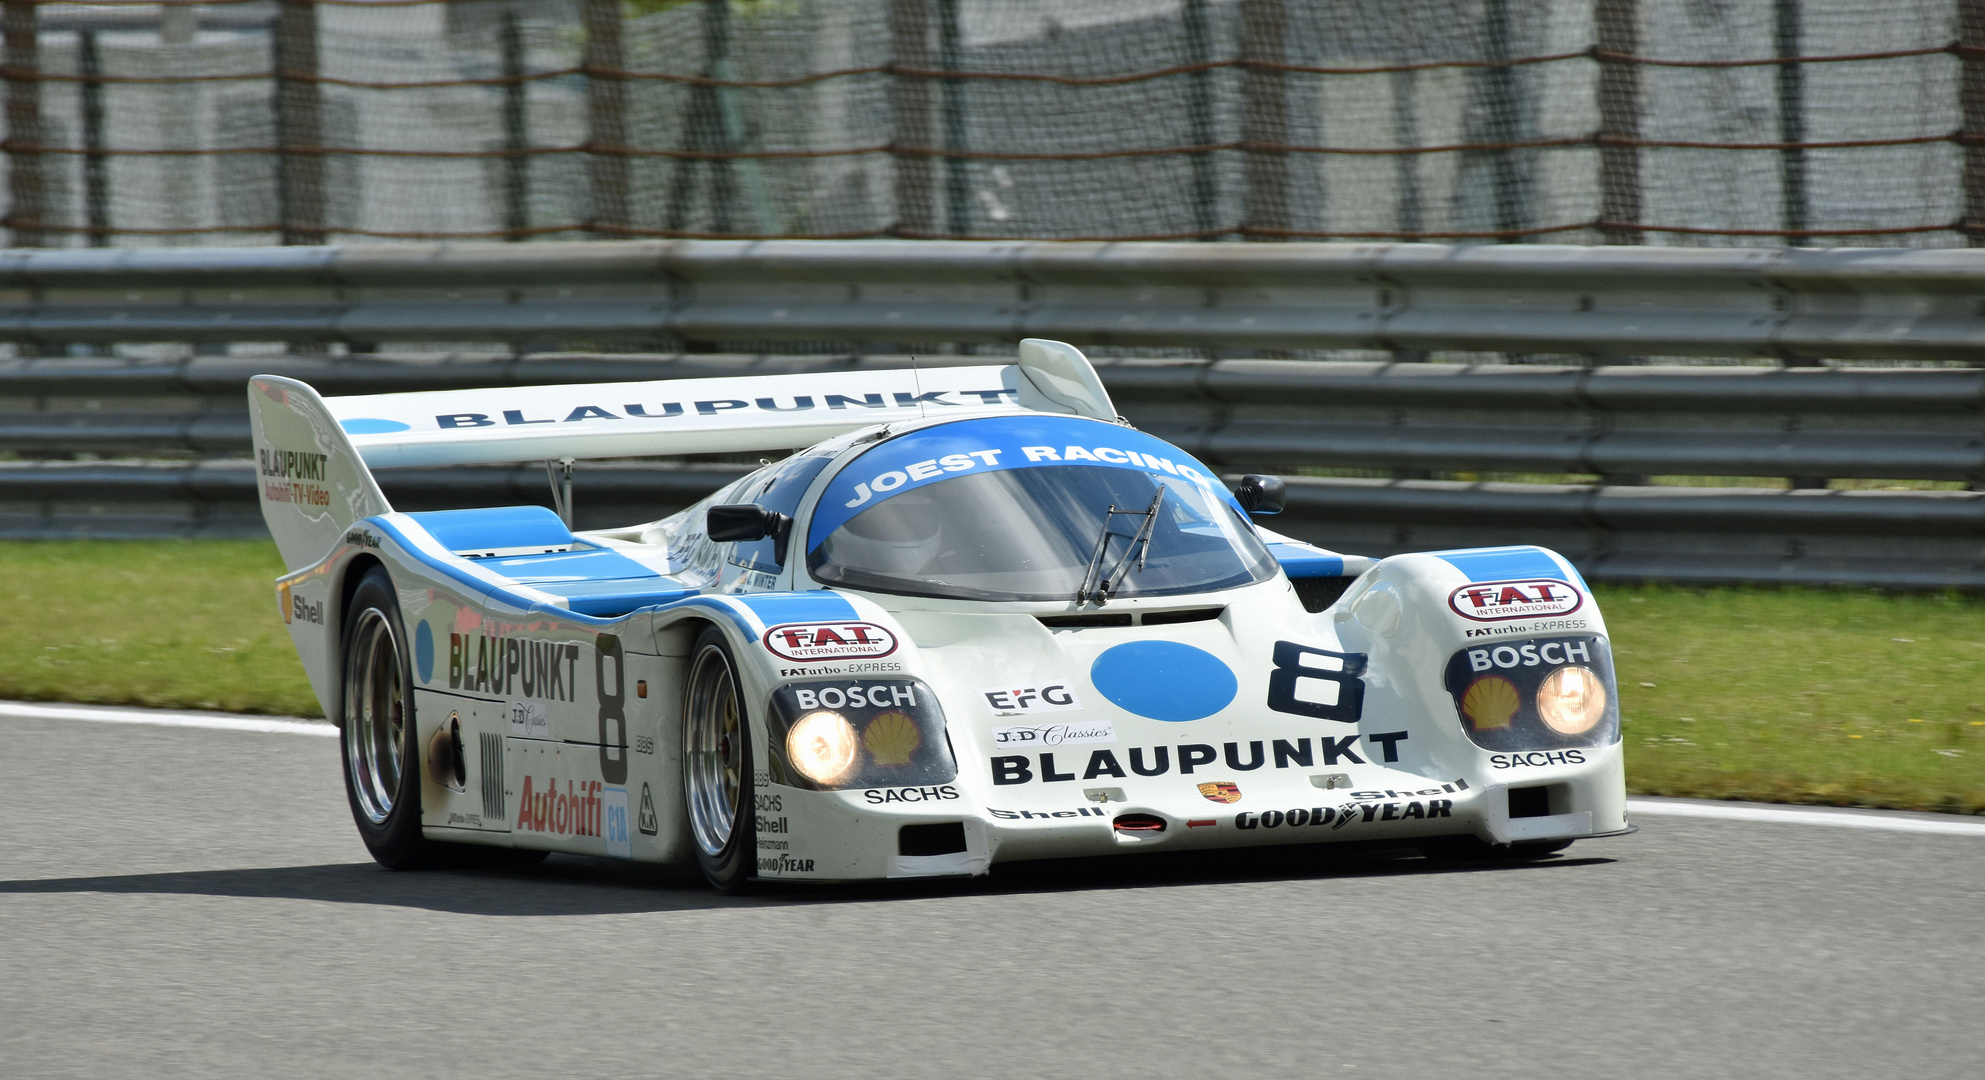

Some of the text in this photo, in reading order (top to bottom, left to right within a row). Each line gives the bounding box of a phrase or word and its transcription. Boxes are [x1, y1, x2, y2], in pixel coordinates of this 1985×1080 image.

[435, 388, 1017, 429] BLAUPUNKT
[260, 448, 327, 481] BLAUPUNKT
[845, 446, 1210, 508] JOEST RACING
[293, 595, 324, 625] Shell
[1476, 604, 1566, 616] INTERNATIONAL
[791, 646, 881, 656] INTERNATIONAL
[1468, 641, 1590, 672] BOSCH
[449, 633, 579, 702] BLAUPUNKT
[1267, 640, 1368, 723] 8
[595, 632, 628, 785] 8
[795, 685, 917, 710] BOSCH
[984, 685, 1074, 710] EFG
[636, 735, 654, 755] BBS
[990, 731, 1408, 786] BLAUPUNKT
[1490, 750, 1586, 769] SACHS
[864, 785, 960, 804] SACHS
[1350, 778, 1470, 800] Shell
[517, 775, 601, 838] Autohifi
[755, 795, 782, 812] SACHS
[986, 806, 1105, 820] Shell
[756, 815, 788, 834] Shell
